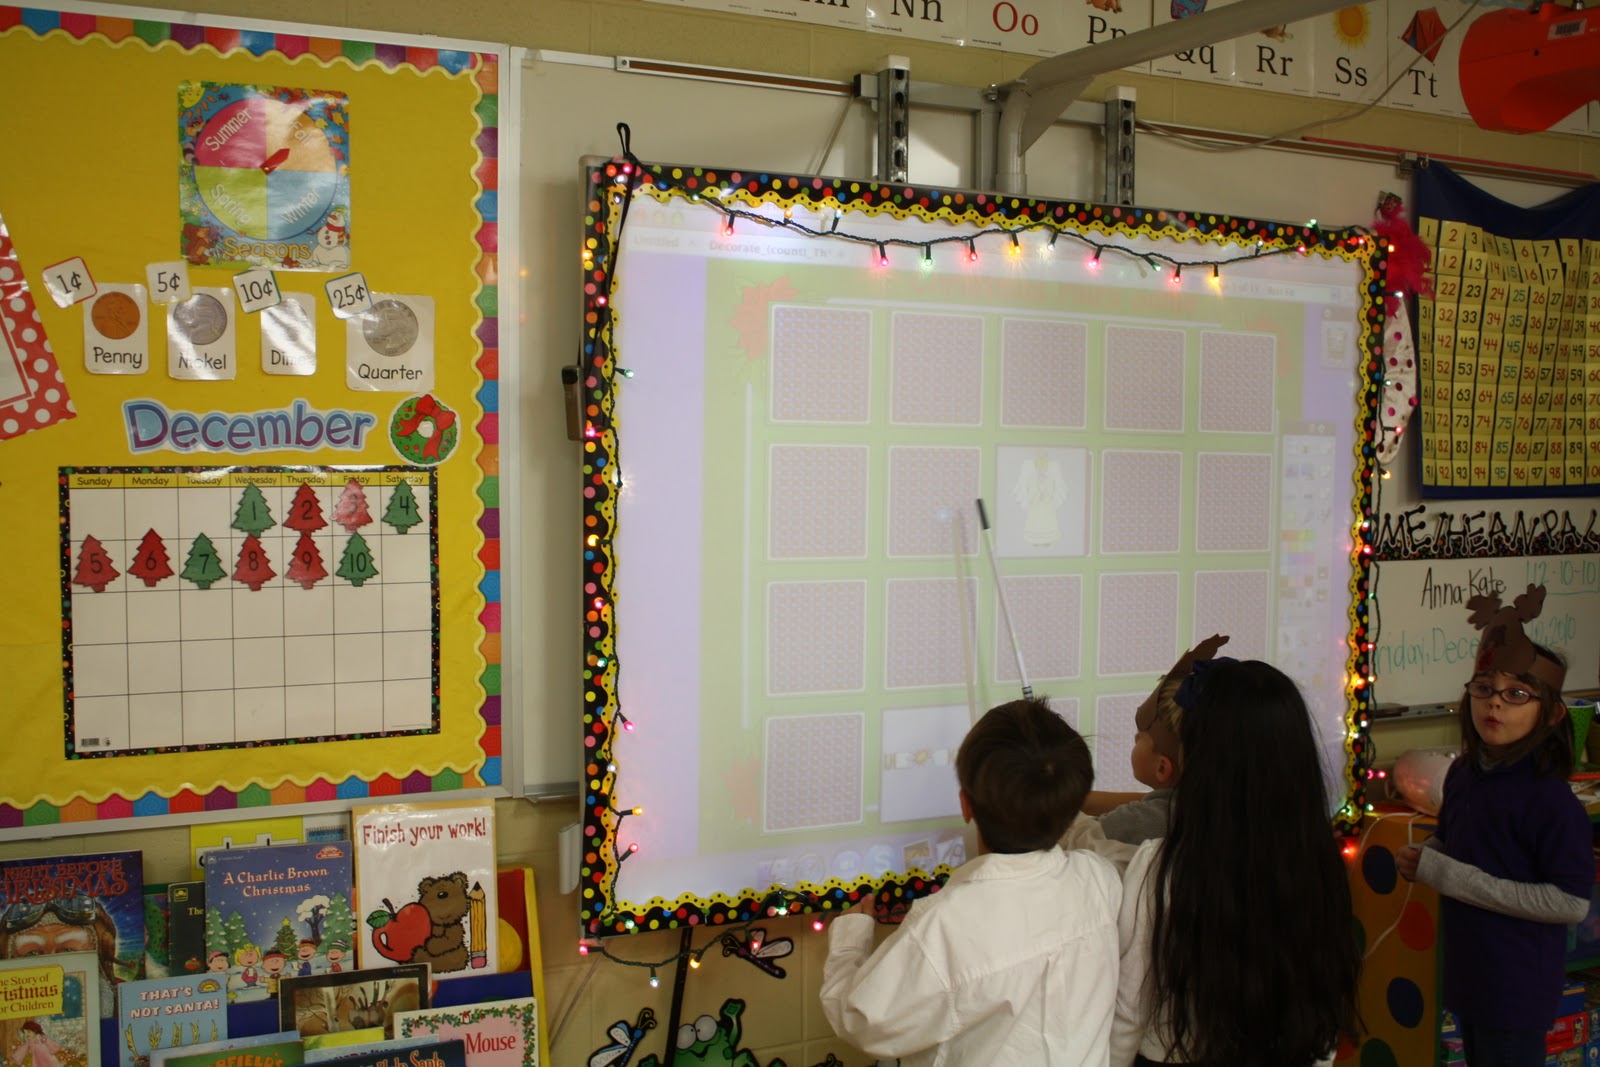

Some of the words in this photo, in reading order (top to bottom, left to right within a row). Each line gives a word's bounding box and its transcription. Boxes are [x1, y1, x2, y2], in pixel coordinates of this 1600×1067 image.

[993, 2, 1038, 36] Oo
[1257, 45, 1293, 76] Rr
[1335, 57, 1367, 86] Ss
[1408, 69, 1438, 97] Tt
[206, 107, 252, 152] Summer
[211, 184, 252, 225] Spring
[281, 188, 319, 223] Winter
[223, 238, 311, 259] Seasons
[1427, 225, 1430, 237] 1
[1449, 229, 1457, 241] 2
[1472, 232, 1478, 244] 3
[1521, 246, 1528, 257] 6
[1542, 246, 1549, 257] 7
[1568, 246, 1574, 256] 8
[1442, 255, 1457, 269] 12
[1469, 259, 1482, 271] 13
[1506, 267, 1517, 278] 15
[1525, 267, 1537, 280] 16
[1547, 269, 1558, 280] 17
[57, 271, 82, 294] 1¢
[158, 272, 180, 292] 5¢
[240, 279, 272, 303] 10¢
[334, 284, 365, 309] 25¢
[1441, 283, 1456, 296] 22
[1466, 285, 1481, 297] 23
[1490, 288, 1504, 300] 24
[1514, 290, 1525, 302] 25
[1533, 292, 1544, 304] 26
[1551, 293, 1561, 305] 27
[1422, 307, 1431, 318] 31
[1439, 309, 1453, 321] 32
[1462, 311, 1477, 323] 33
[1487, 313, 1500, 325] 34
[1509, 315, 1522, 327] 35
[1530, 317, 1541, 329] 36
[1548, 318, 1558, 329] 37
[1575, 321, 1584, 332] 39
[1438, 336, 1451, 348] 42
[1461, 338, 1475, 349] 43
[1484, 339, 1497, 350] 44
[1507, 341, 1520, 353] 45
[1527, 342, 1538, 354] 46
[1573, 345, 1583, 357] 49
[94, 347, 143, 369] Penny
[179, 353, 226, 369] Nckel
[358, 364, 423, 380] Quarter
[1423, 360, 1430, 371] 51
[1437, 361, 1449, 374] 52
[1458, 363, 1472, 375] 53
[1481, 364, 1495, 376] 54
[1504, 366, 1517, 378] 55
[1524, 368, 1535, 379] 56
[1540, 368, 1550, 380] 57
[1571, 369, 1582, 381] 59
[1424, 387, 1431, 398] 61
[1437, 388, 1449, 400] 62
[1456, 389, 1470, 401] 63
[1479, 390, 1492, 402] 64
[1501, 392, 1514, 404] 65
[1521, 393, 1532, 405] 66
[1538, 393, 1549, 405] 67
[1554, 393, 1563, 405] 68
[1570, 394, 1582, 405] 69
[126, 402, 373, 451] December
[1437, 414, 1449, 426] 72
[1456, 415, 1469, 427] 73
[1476, 416, 1491, 428] 74
[1498, 417, 1512, 430] 75
[1517, 417, 1529, 430] 76
[1535, 418, 1547, 430] 77
[1551, 418, 1562, 430] 78
[1569, 418, 1582, 430] 79
[1425, 439, 1433, 451] 81
[1438, 440, 1448, 452] 82
[1456, 441, 1468, 453] 83
[1475, 441, 1487, 454] 84
[1496, 442, 1509, 454] 85
[1515, 442, 1527, 454] 86
[1533, 442, 1544, 454] 87
[1551, 442, 1562, 454] 88
[1570, 442, 1582, 454] 89
[78, 477, 112, 486] Sunday
[132, 477, 169, 486] Monday
[187, 477, 221, 486] Tuesday
[235, 476, 277, 484] Wednesday
[287, 476, 326, 484] Thursday
[344, 476, 370, 484] Frday
[1426, 465, 1433, 477] 91
[1439, 466, 1449, 479] 92
[1456, 467, 1467, 479] 93
[1474, 467, 1486, 479] 94
[1495, 468, 1506, 480] 95
[1514, 468, 1525, 480] 96
[1532, 467, 1542, 480] 97
[1550, 466, 1560, 479] 98
[1570, 466, 1582, 478] 99
[252, 502, 256, 520] 1
[302, 501, 313, 520] 2
[350, 494, 358, 513] 3
[400, 496, 410, 515] 4
[90, 553, 103, 574] 5
[146, 551, 156, 570] 6
[199, 554, 209, 574] 7
[249, 551, 259, 571] 8
[302, 551, 312, 571] 9
[350, 552, 367, 572] 10
[1421, 566, 1506, 609] Anna-Kate
[1373, 630, 1430, 675] riday,
[363, 823, 405, 845] Finish
[410, 824, 443, 846] your
[448, 817, 486, 838] work!
[4, 865, 53, 881] NIGHT
[56, 860, 122, 877] BEFORE
[224, 872, 235, 885] A
[238, 869, 285, 883] Charlie
[287, 867, 328, 879] Brown
[243, 884, 310, 897] Christmas
[188, 907, 204, 915] The
[10, 976, 38, 986] Story
[39, 973, 50, 982] of
[0, 985, 58, 1001] istmas
[140, 987, 192, 1001] THAT'S
[10, 1001, 54, 1012] Children
[130, 1007, 160, 1019] NOT
[165, 998, 220, 1015] SANTA!
[465, 1033, 516, 1055] Mouse
